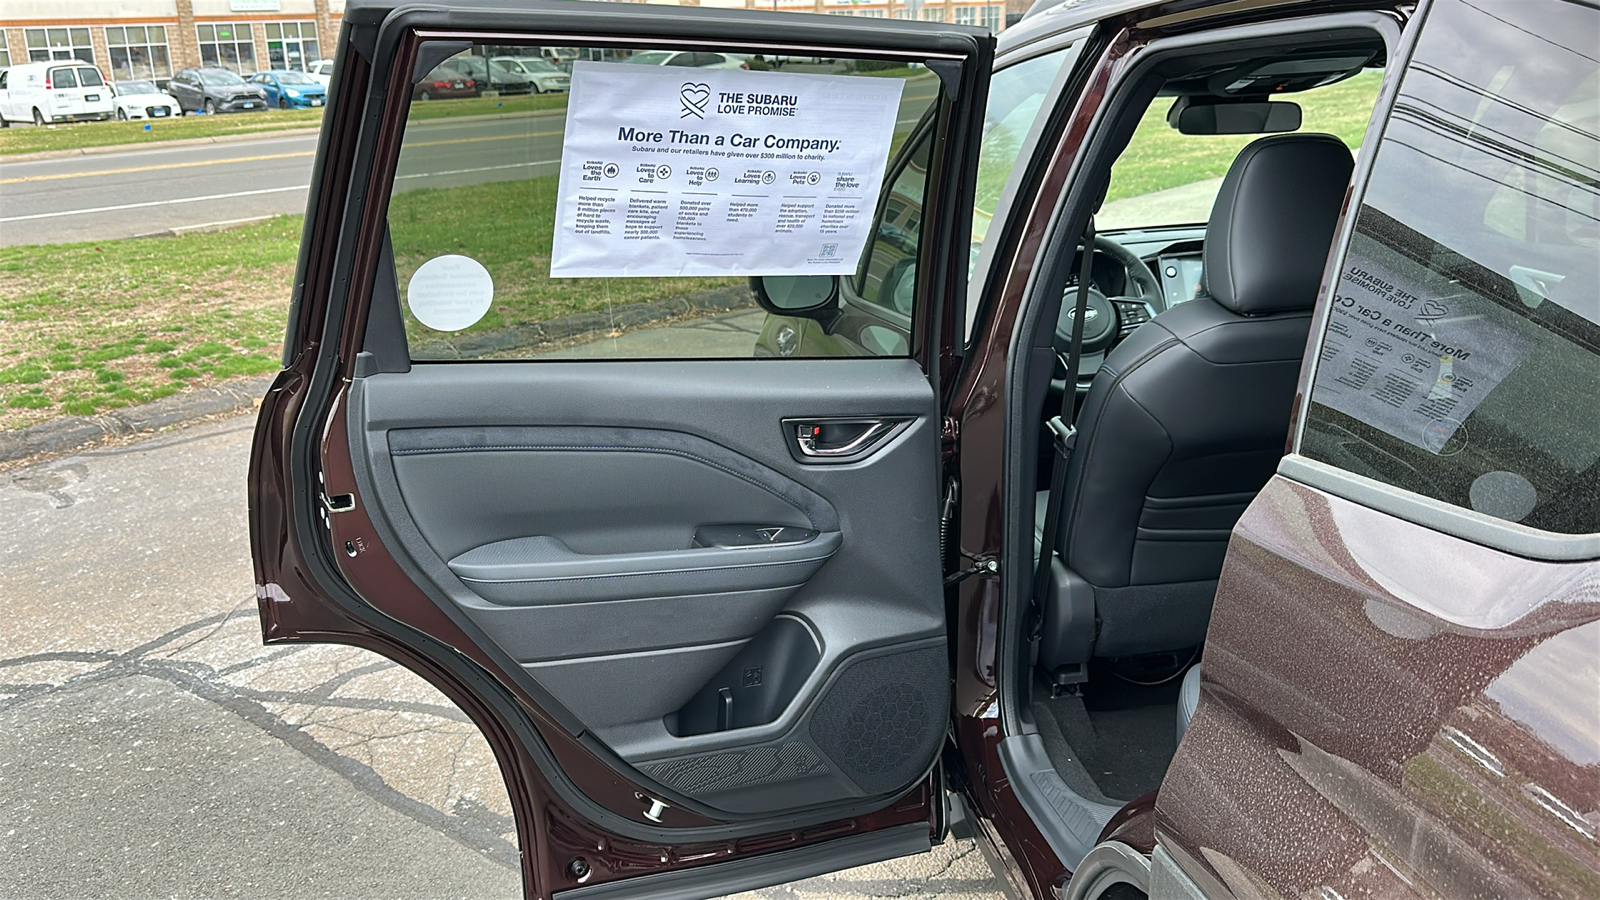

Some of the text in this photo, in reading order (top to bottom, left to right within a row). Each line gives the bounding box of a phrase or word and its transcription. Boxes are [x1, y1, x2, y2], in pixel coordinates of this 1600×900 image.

[719, 92, 798, 106] THE SUBARU
[717, 104, 796, 116] LOVE PROMISE
[618, 127, 840, 153] More Than a Car Company.
[632, 145, 655, 153] Subaru
[682, 148, 709, 156] retailers
